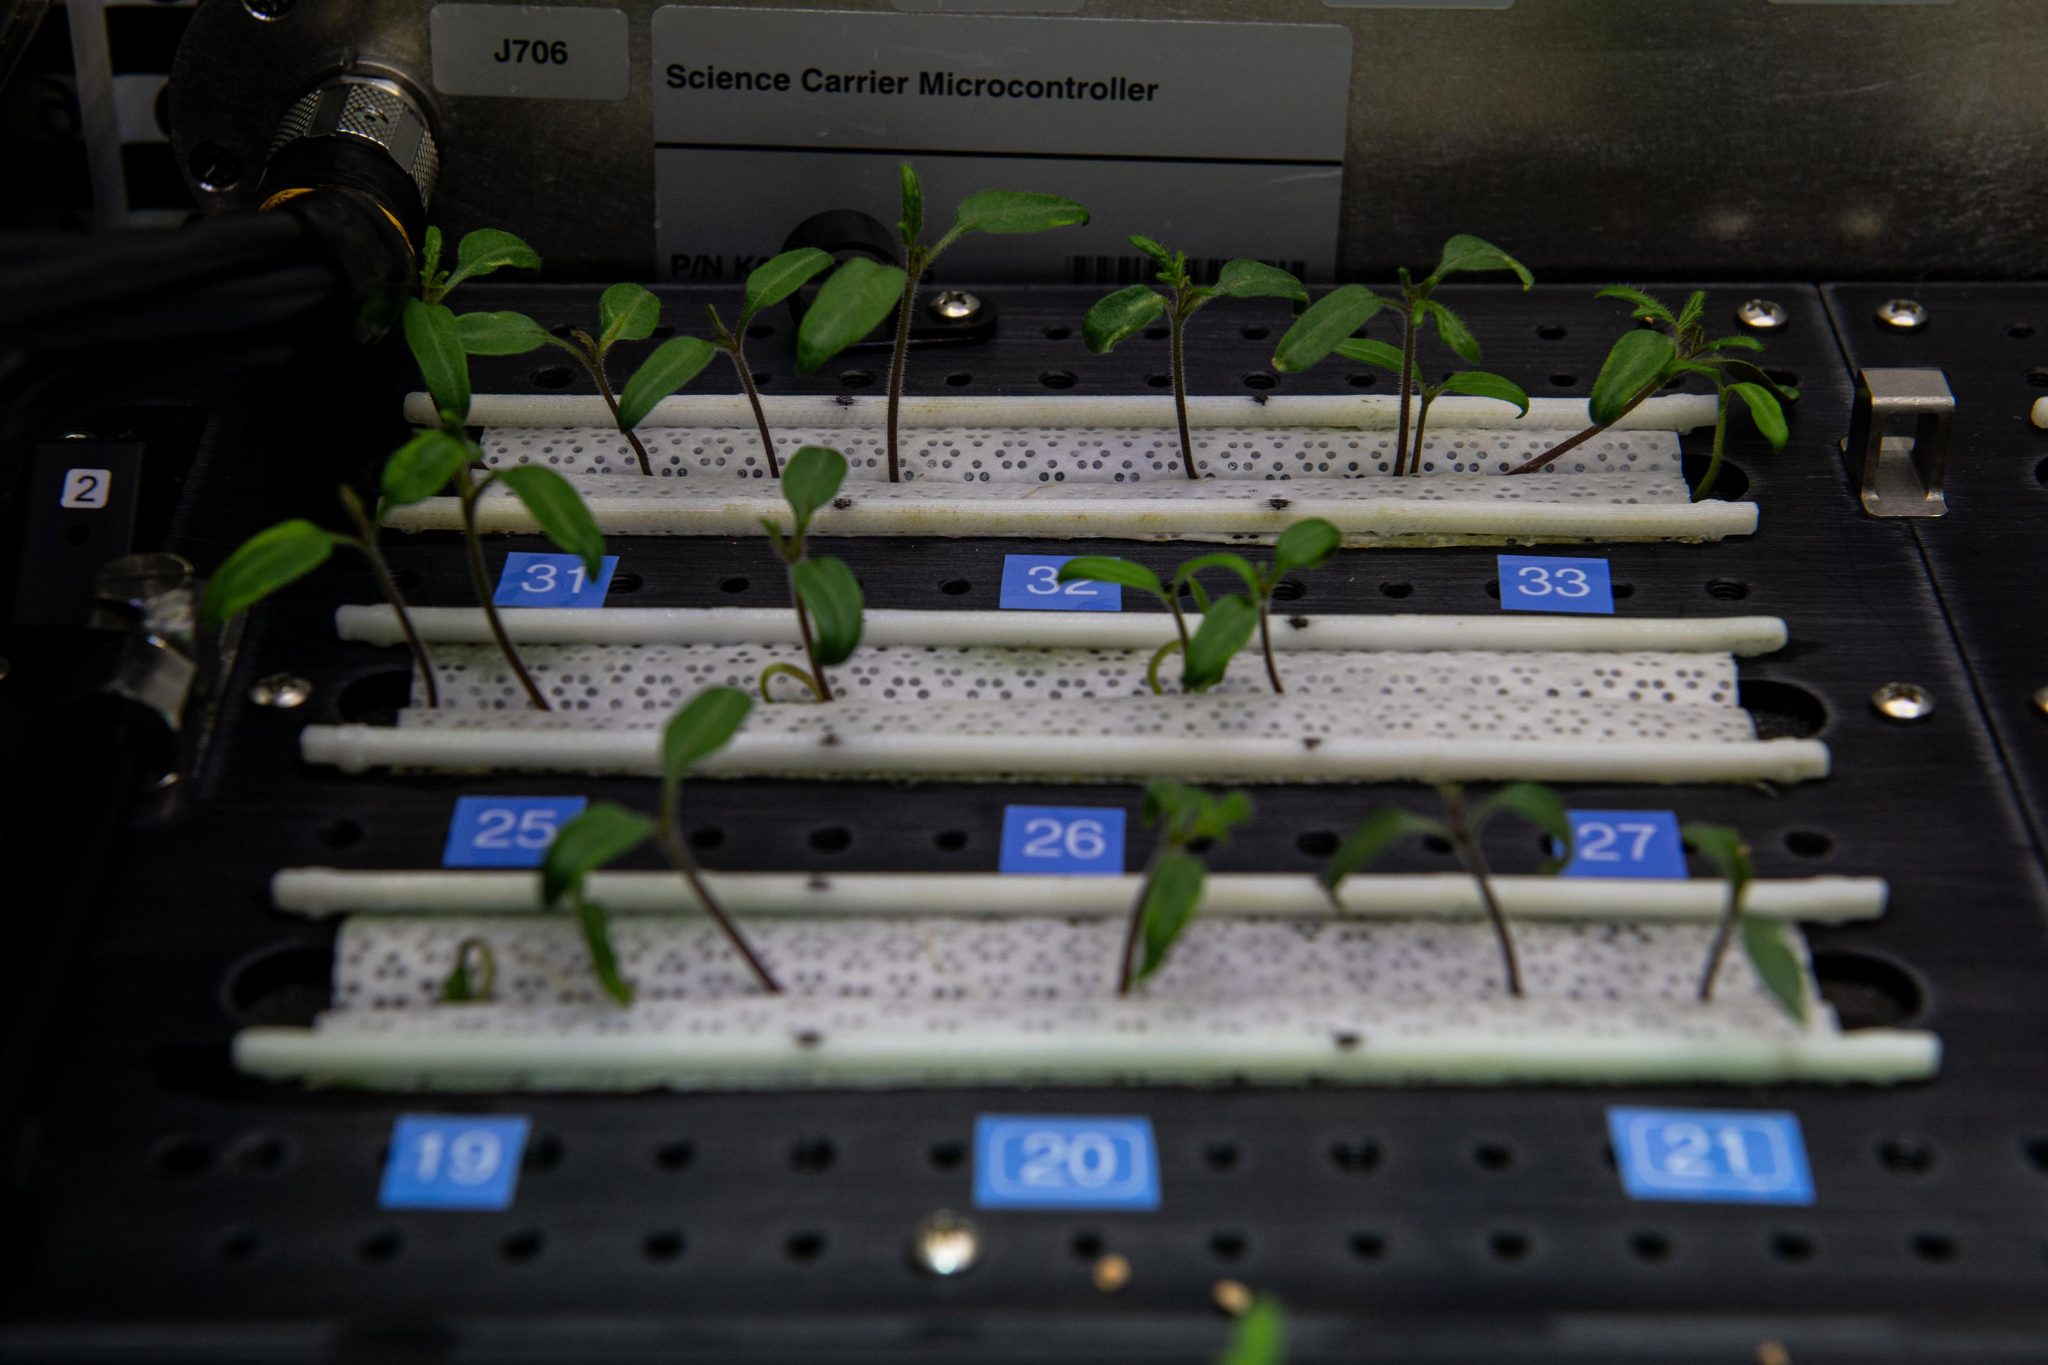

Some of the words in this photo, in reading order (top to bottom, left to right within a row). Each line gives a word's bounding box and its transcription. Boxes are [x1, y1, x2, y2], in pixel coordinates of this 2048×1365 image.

[494, 38, 568, 65] J706
[666, 63, 790, 91] Science
[801, 68, 908, 94] Carrier
[919, 71, 1158, 101] Microcontroller
[671, 254, 722, 277] P/N
[74, 475, 97, 502] 2
[521, 563, 588, 594] 31
[1518, 566, 1591, 597] 33
[473, 808, 558, 849] 25
[1022, 818, 1106, 860] 26
[1577, 821, 1657, 861] 27
[412, 1129, 502, 1186] 19
[1019, 1131, 1118, 1188] 20
[1662, 1122, 1751, 1179] 21
